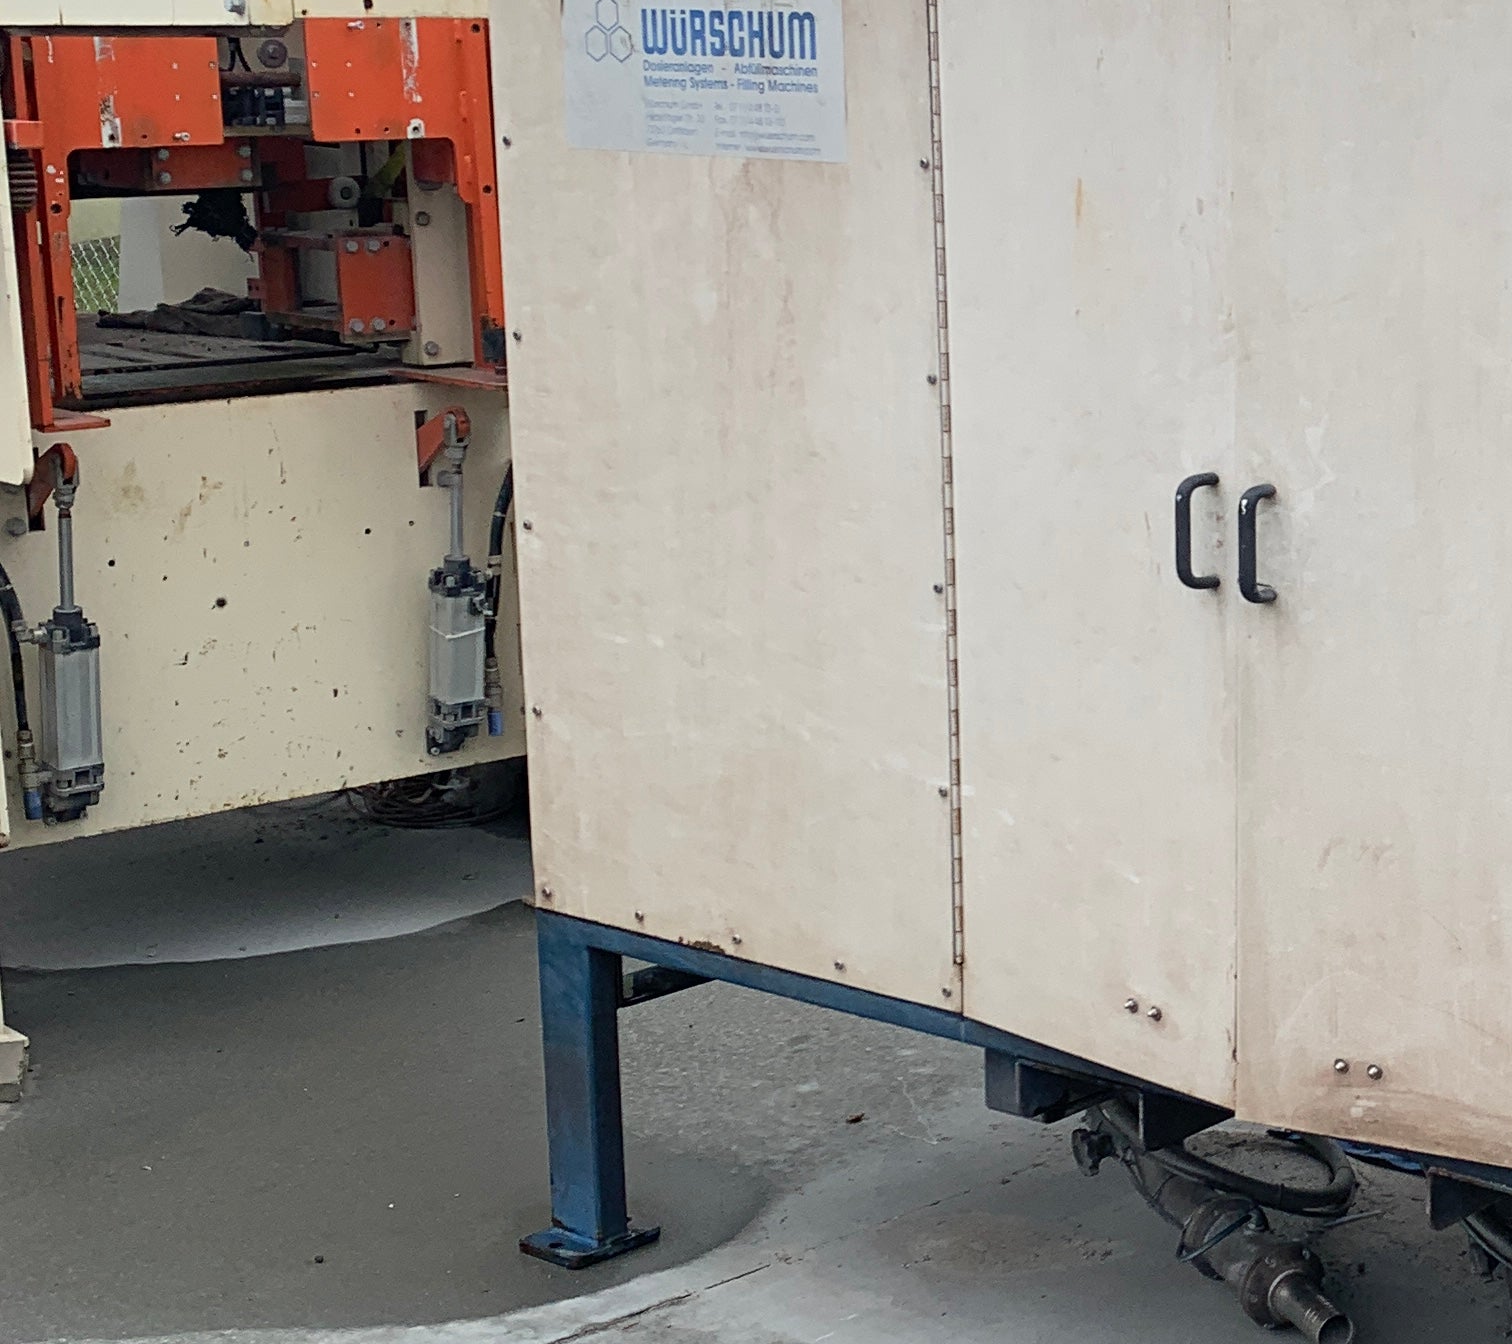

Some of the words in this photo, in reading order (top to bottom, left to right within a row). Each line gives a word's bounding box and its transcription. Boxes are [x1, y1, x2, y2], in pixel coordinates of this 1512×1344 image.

[641, 8, 817, 60] WÜRSCHUM
[642, 59, 714, 75] Dosieranlagen
[734, 62, 818, 77] Abfüllmaschinen
[643, 76, 687, 91] Metering
[690, 76, 729, 91] Systems
[737, 78, 765, 94] Filling
[768, 80, 819, 94] Machines
